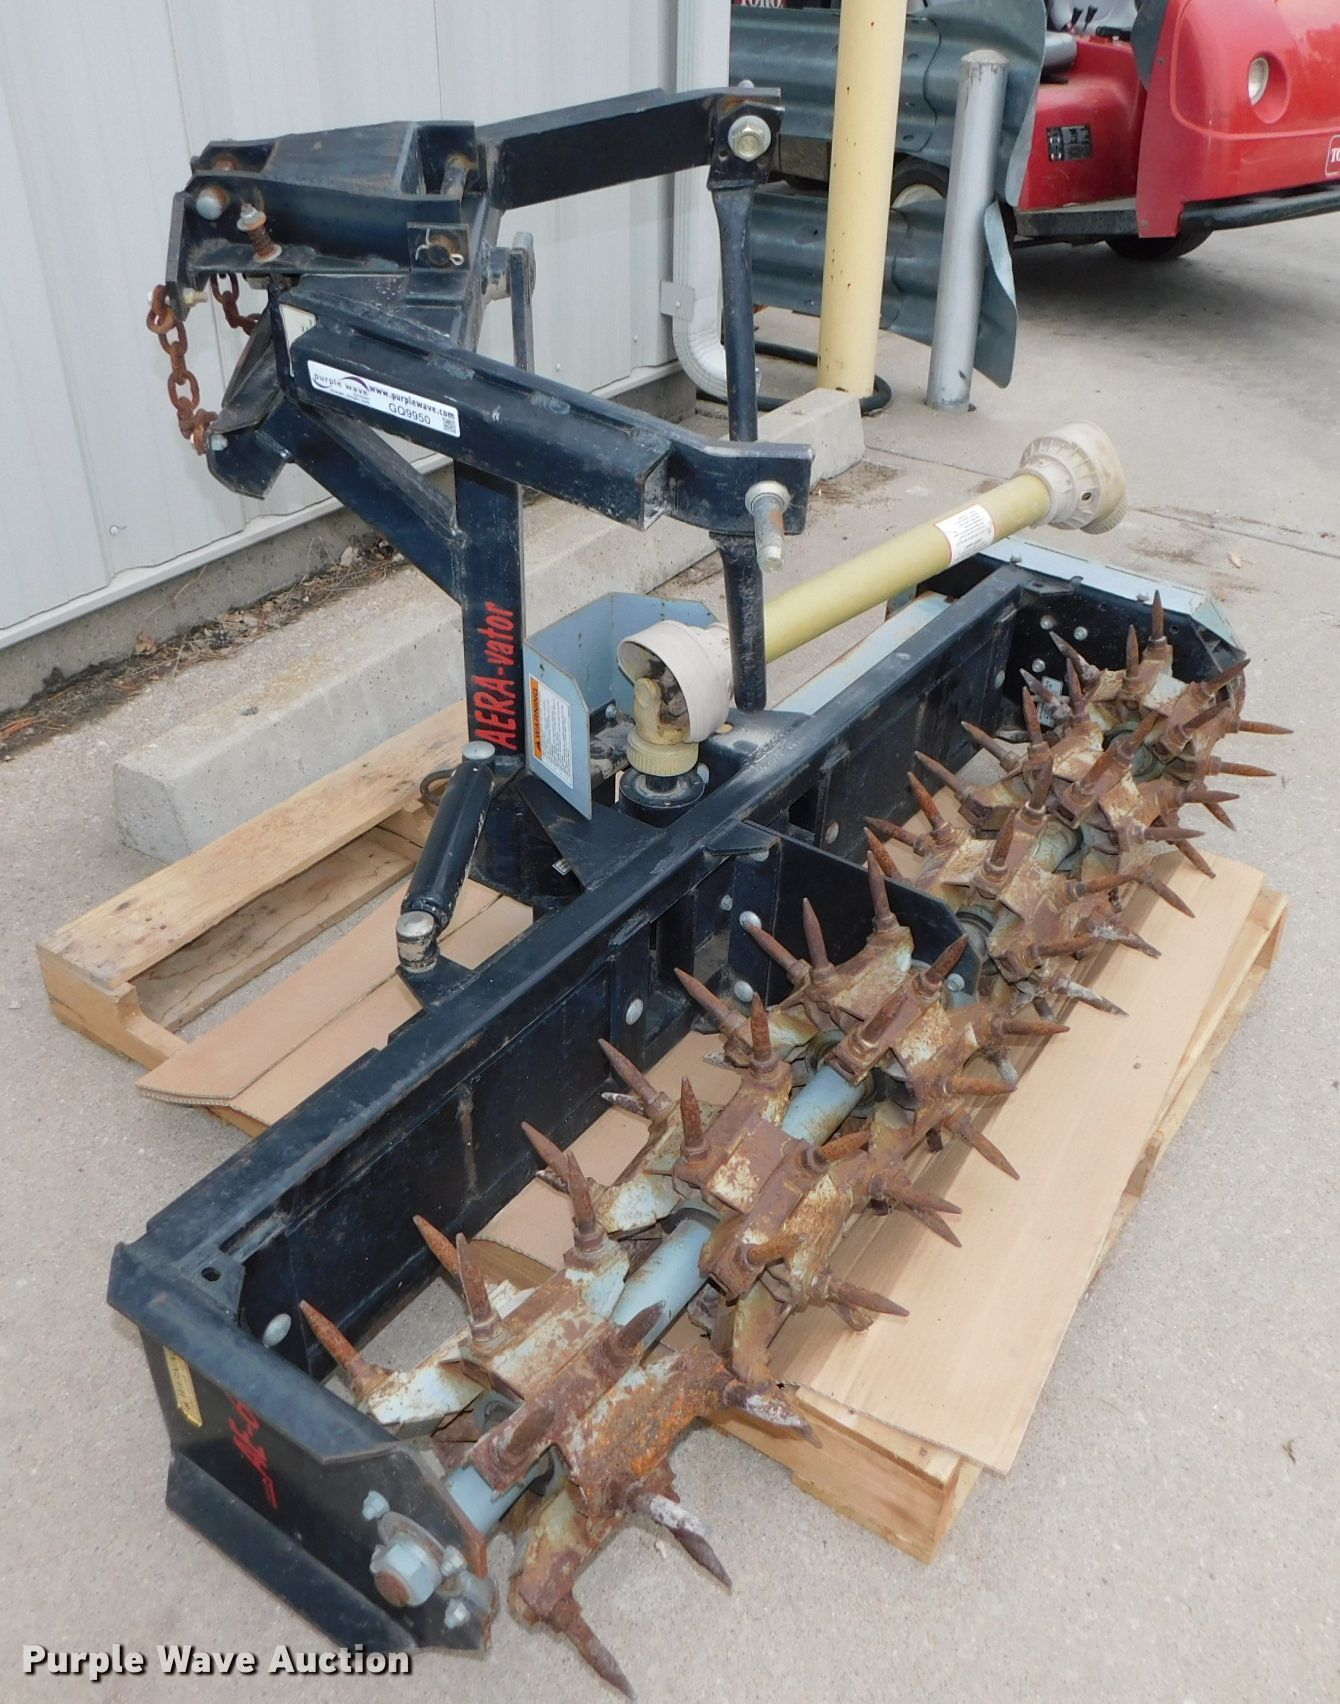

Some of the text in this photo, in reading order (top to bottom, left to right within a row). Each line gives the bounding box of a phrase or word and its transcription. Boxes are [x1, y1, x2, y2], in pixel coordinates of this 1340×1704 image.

[314, 373, 368, 396] purple wave
[369, 385, 455, 419] www.purplewave.com
[388, 402, 431, 425] GQ9950
